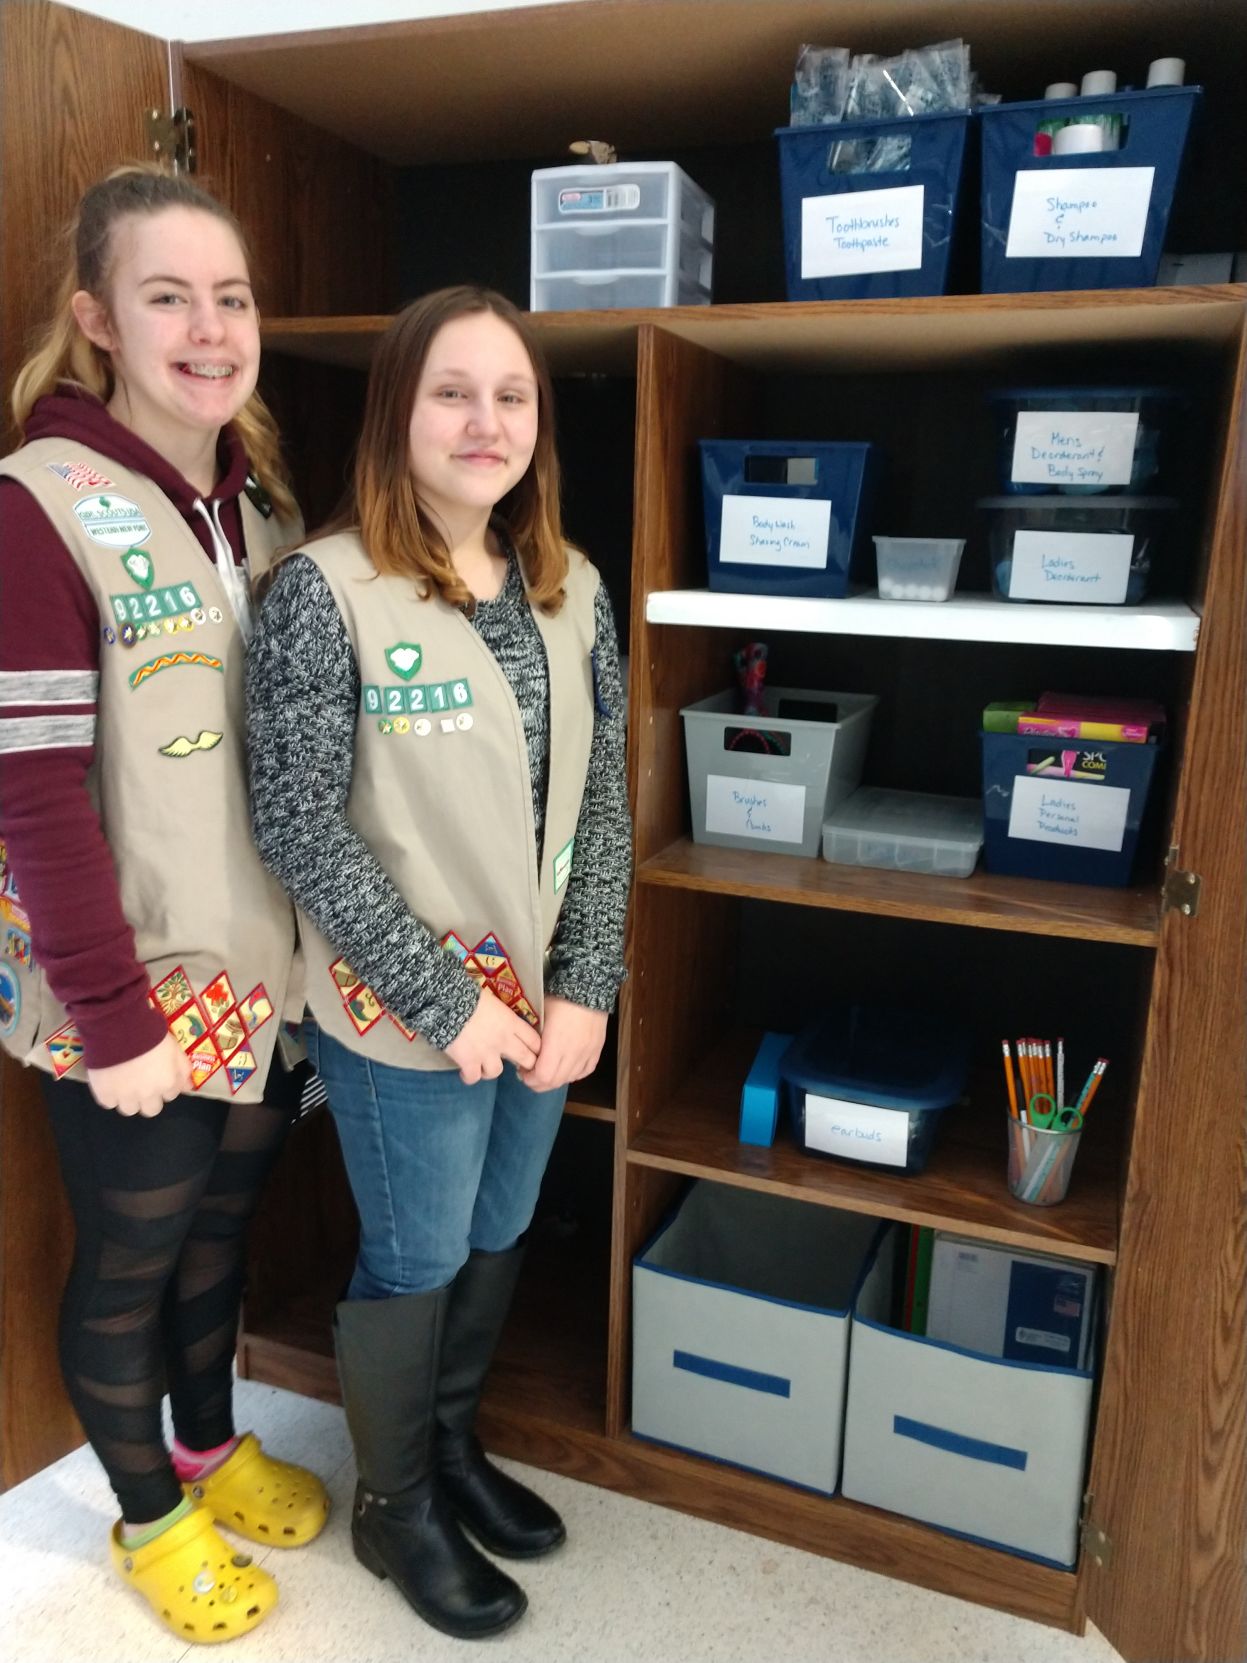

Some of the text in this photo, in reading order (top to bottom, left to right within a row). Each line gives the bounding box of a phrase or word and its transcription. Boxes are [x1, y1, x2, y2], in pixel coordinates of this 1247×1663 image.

[1046, 197, 1098, 213] Shampoo
[826, 213, 900, 234] Toothbrushes
[833, 236, 889, 252] Toothpaste
[1044, 231, 1118, 248] Dry Shampoo
[1047, 464, 1104, 483] Body Spray
[1041, 553, 1075, 570] Ladies
[113, 586, 197, 621] 92216
[366, 682, 469, 712] 92216
[192, 1060, 212, 1073] Plan
[831, 1124, 882, 1142] earbuds
